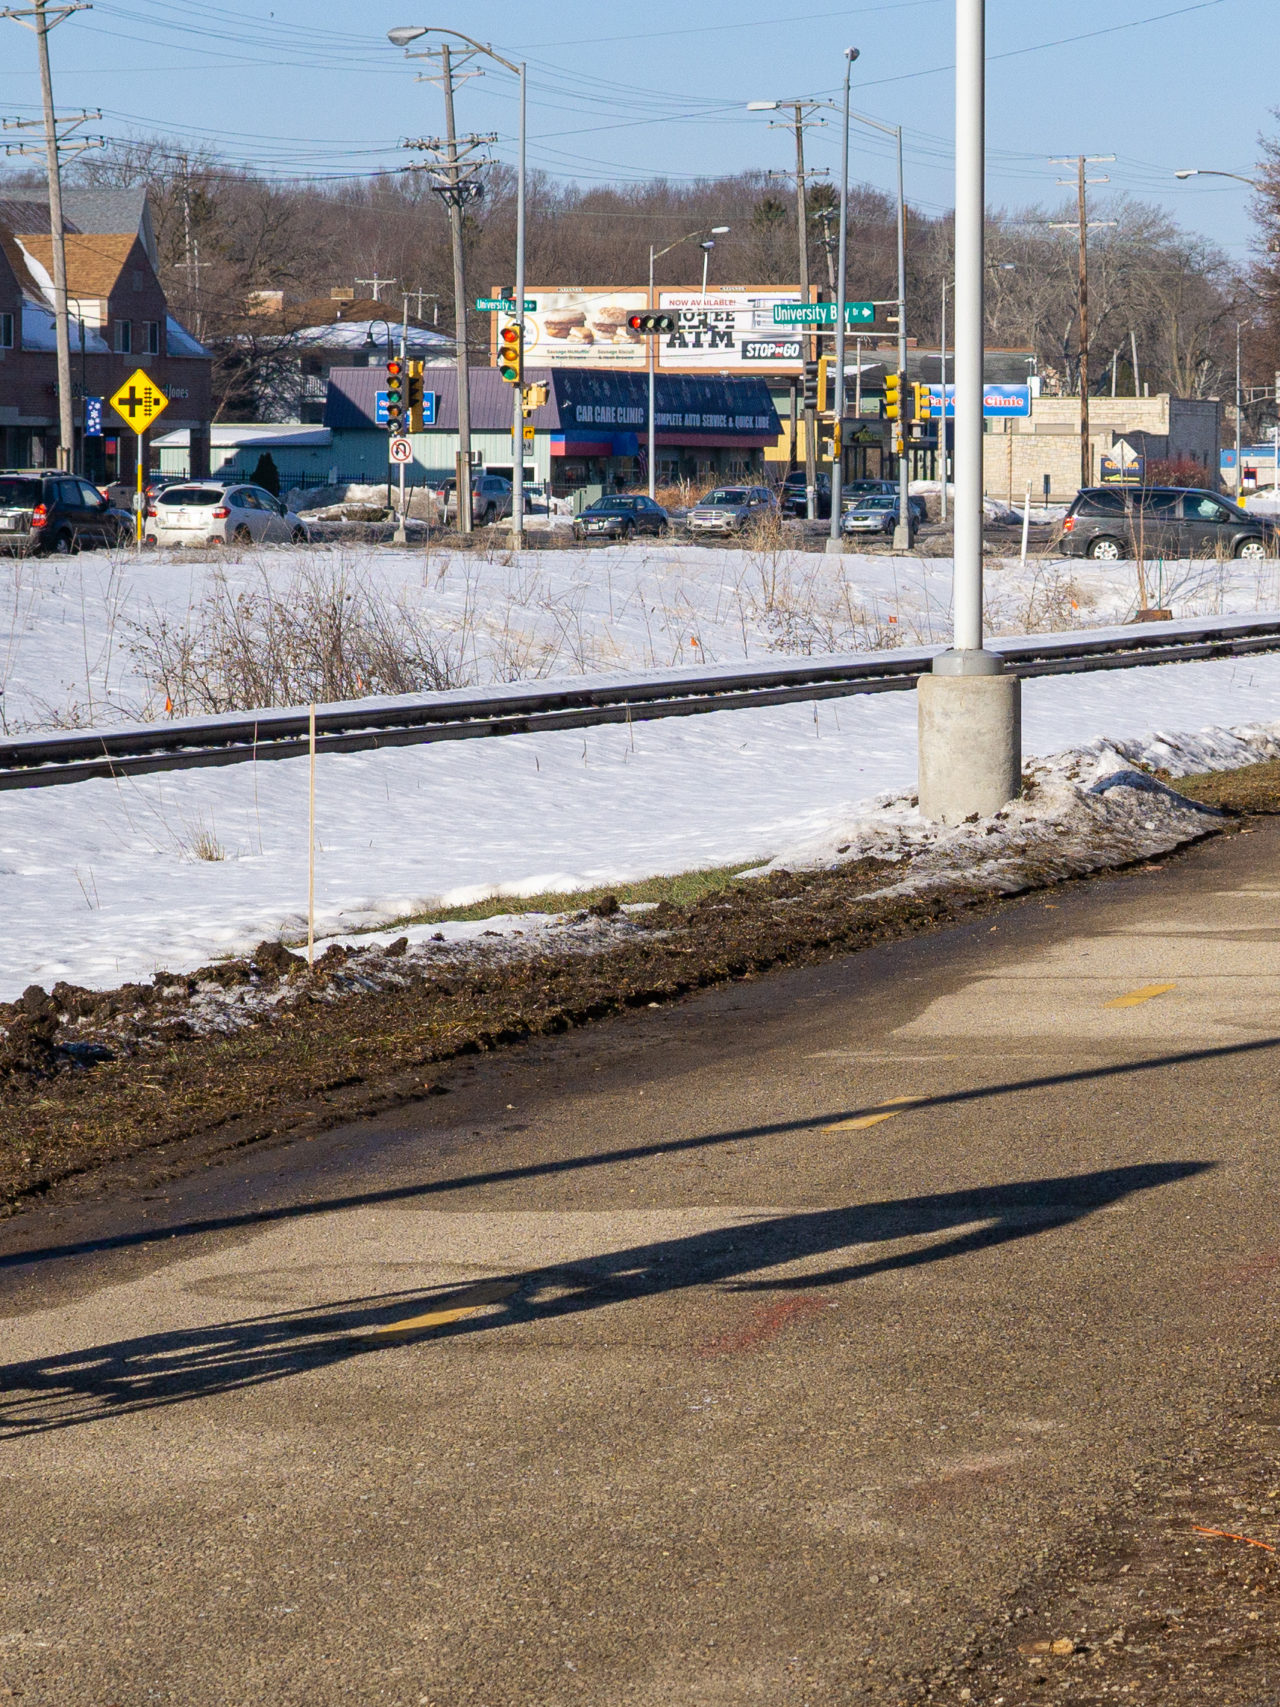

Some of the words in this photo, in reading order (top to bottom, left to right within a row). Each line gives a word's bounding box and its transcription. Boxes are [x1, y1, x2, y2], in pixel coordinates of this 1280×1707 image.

[477, 298, 509, 311] University
[774, 305, 827, 323] University
[830, 305, 850, 323] By
[666, 325, 736, 348] ATM
[984, 395, 1024, 407] Clinic
[576, 405, 593, 422] CAR
[595, 406, 616, 423] CARE
[617, 406, 644, 424] CLINIC
[654, 412, 682, 426] COMPLETE
[684, 413, 701, 427] AUTO
[702, 414, 727, 428] SERVICE
[735, 415, 754, 430] QUICK
[755, 415, 770, 429] LUBE
